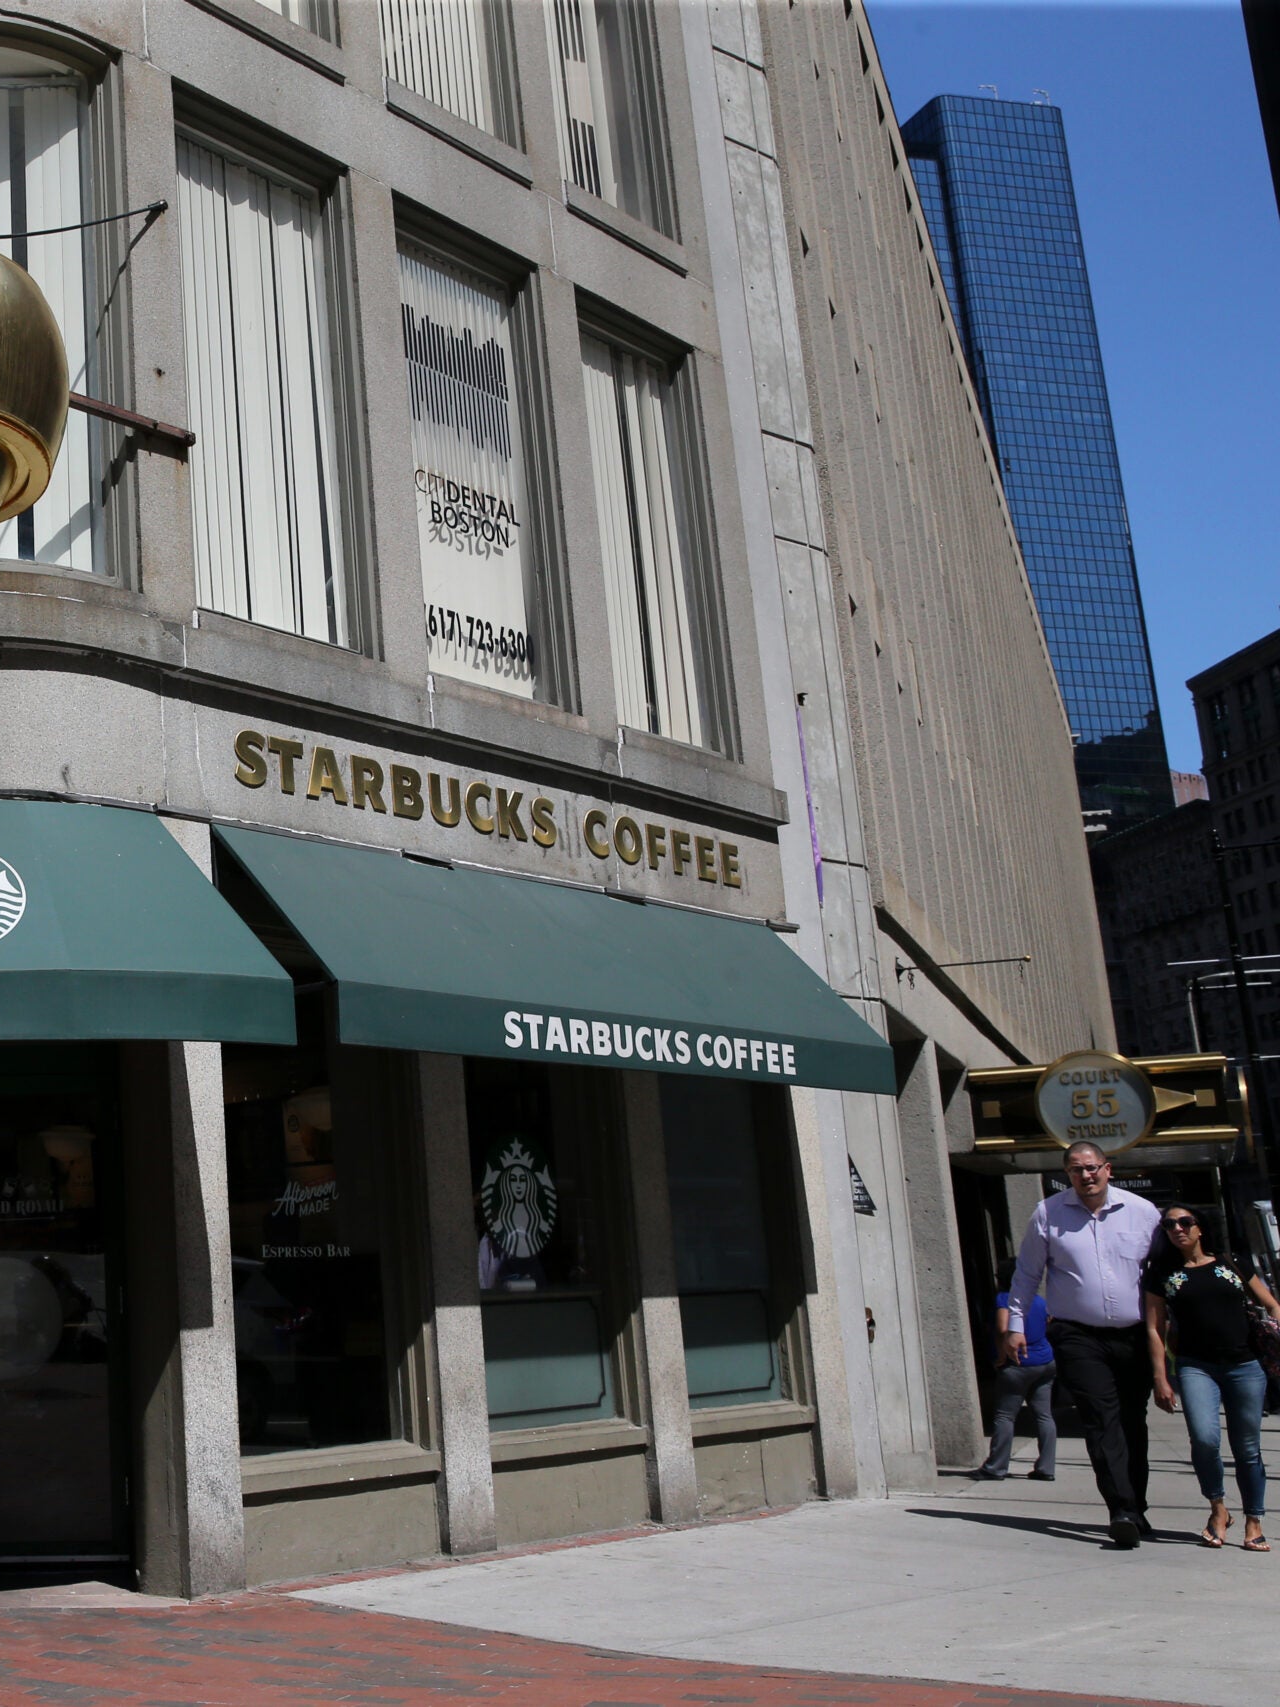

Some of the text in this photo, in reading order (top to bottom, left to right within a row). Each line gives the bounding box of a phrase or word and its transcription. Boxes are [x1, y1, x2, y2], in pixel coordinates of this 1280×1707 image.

[414, 469, 520, 527] CITIDENTAL
[430, 500, 509, 548] BOSTON
[466, 615, 534, 665] 723-6300
[234, 730, 742, 888] STARBUCKS COFFEE
[503, 1011, 797, 1077] STARBUCKS COFFEE
[1059, 1069, 1121, 1087] COURT
[1071, 1089, 1120, 1119] 55
[1067, 1122, 1127, 1139] STREET
[271, 1180, 340, 1216] Afternoon
[299, 1198, 330, 1217] MADE
